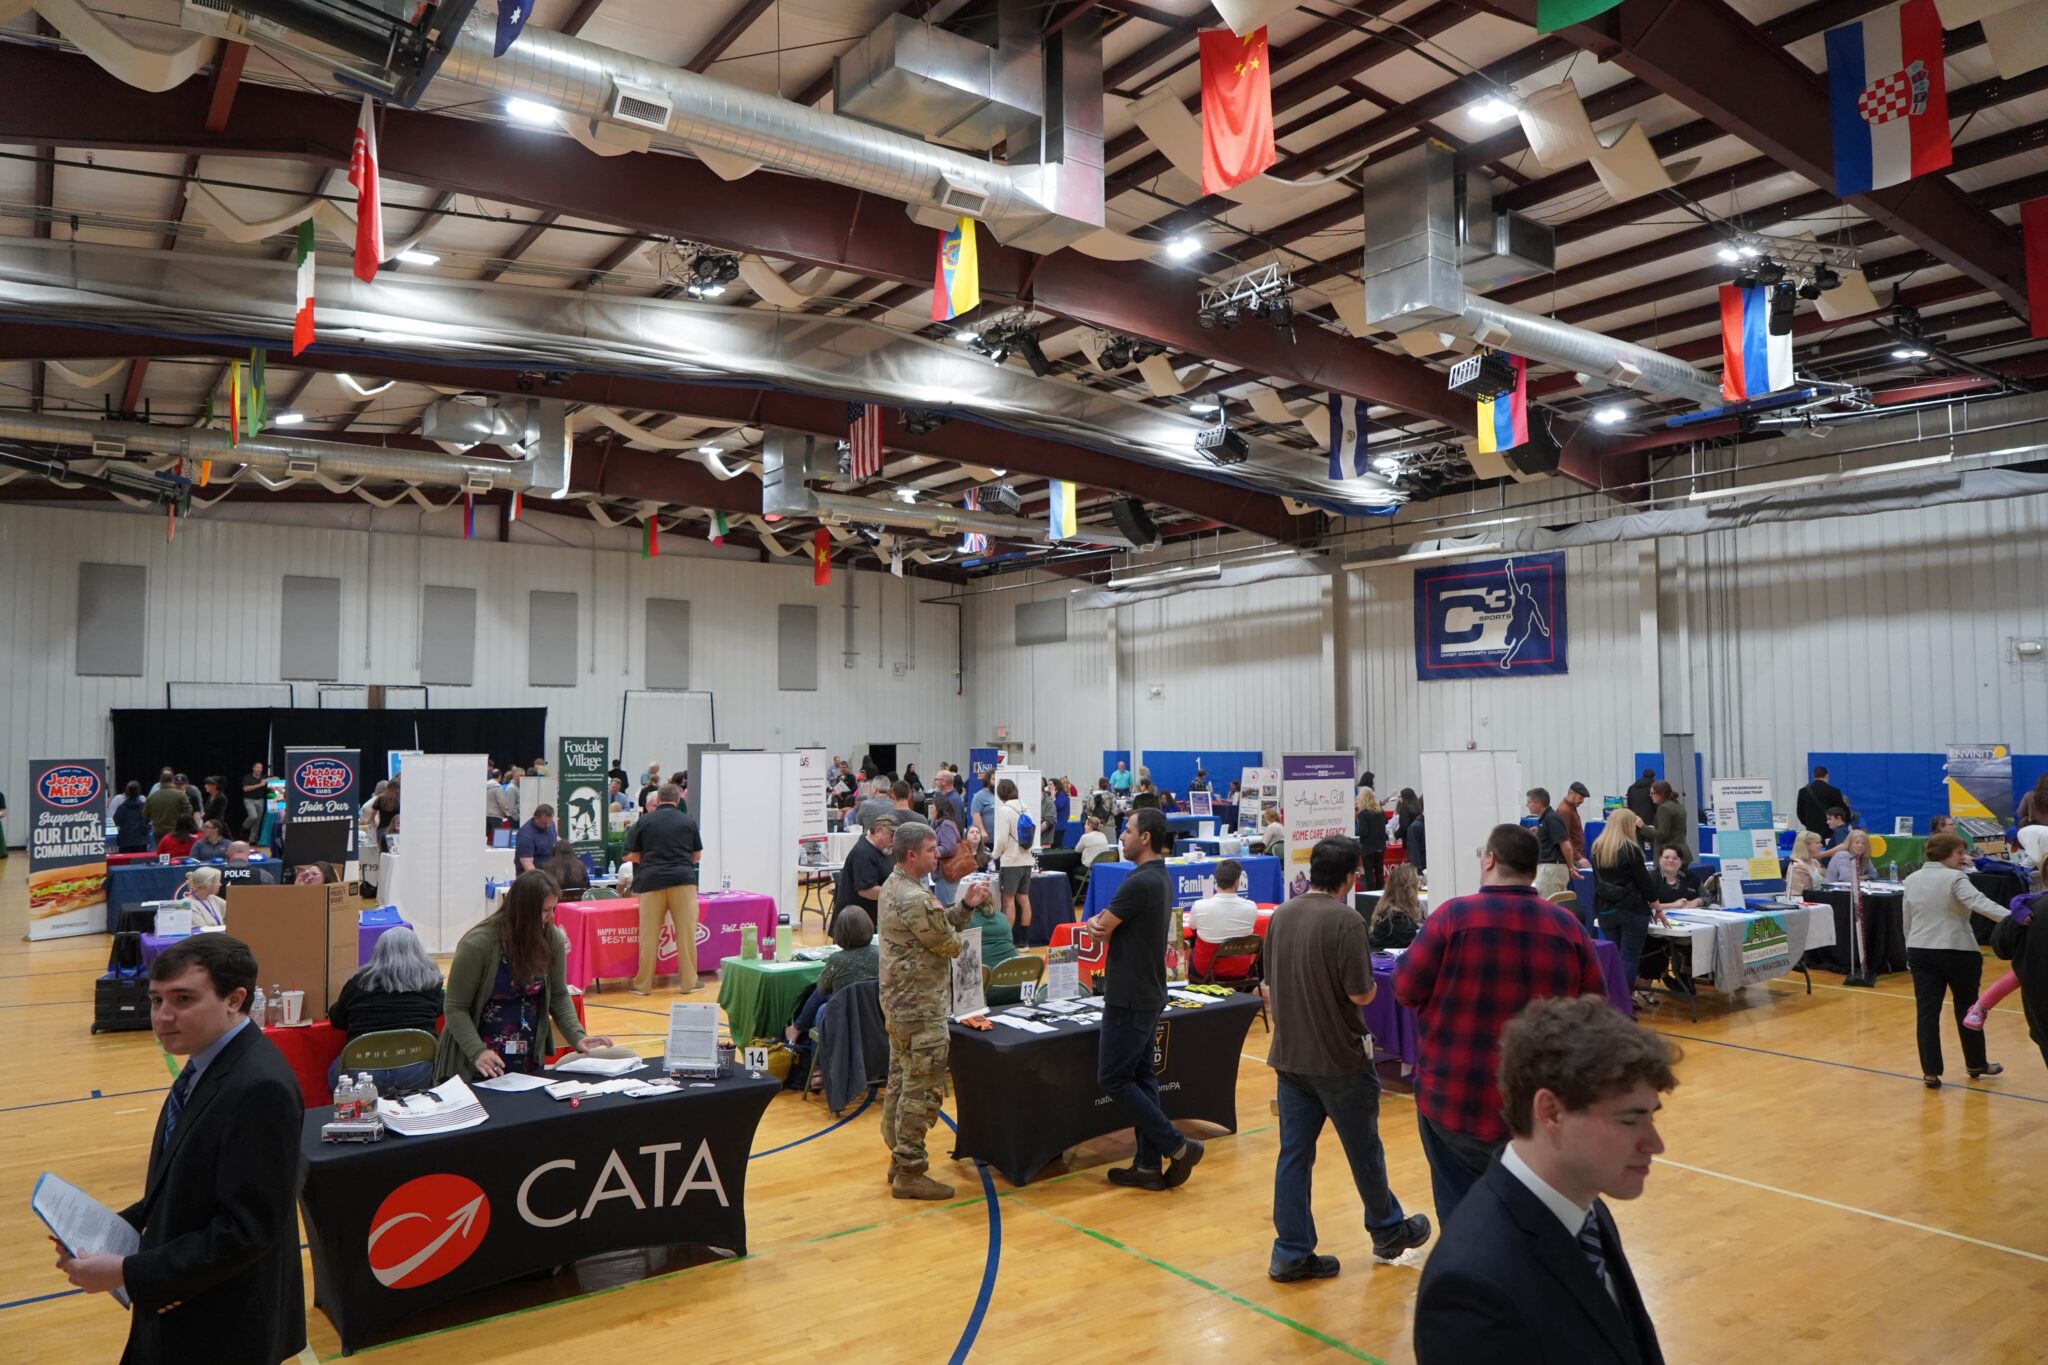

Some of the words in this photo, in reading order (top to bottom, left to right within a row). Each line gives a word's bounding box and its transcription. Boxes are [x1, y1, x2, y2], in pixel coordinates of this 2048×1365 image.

[564, 740, 604, 753] Foxdale
[1949, 749, 1996, 759] ENVINITY
[566, 754, 602, 771] Village
[302, 765, 345, 777] Jersey
[46, 773, 93, 787] Jersey
[298, 801, 324, 814] Join
[326, 800, 349, 813] Our
[38, 810, 101, 826] Supporting
[34, 827, 61, 844] OUR
[65, 825, 106, 843] LOCAL
[1292, 830, 1308, 841] HOME
[1310, 829, 1324, 840] CARE
[1325, 827, 1346, 838] AGENCY
[34, 842, 105, 859] COMMUNITIES
[224, 869, 250, 878] POLICE
[722, 881, 731, 889] 28
[597, 928, 616, 936] HAPPY
[601, 936, 626, 944] BEST
[1023, 985, 1033, 996] 13
[749, 1051, 764, 1067] 14
[516, 1138, 730, 1228] CATA
